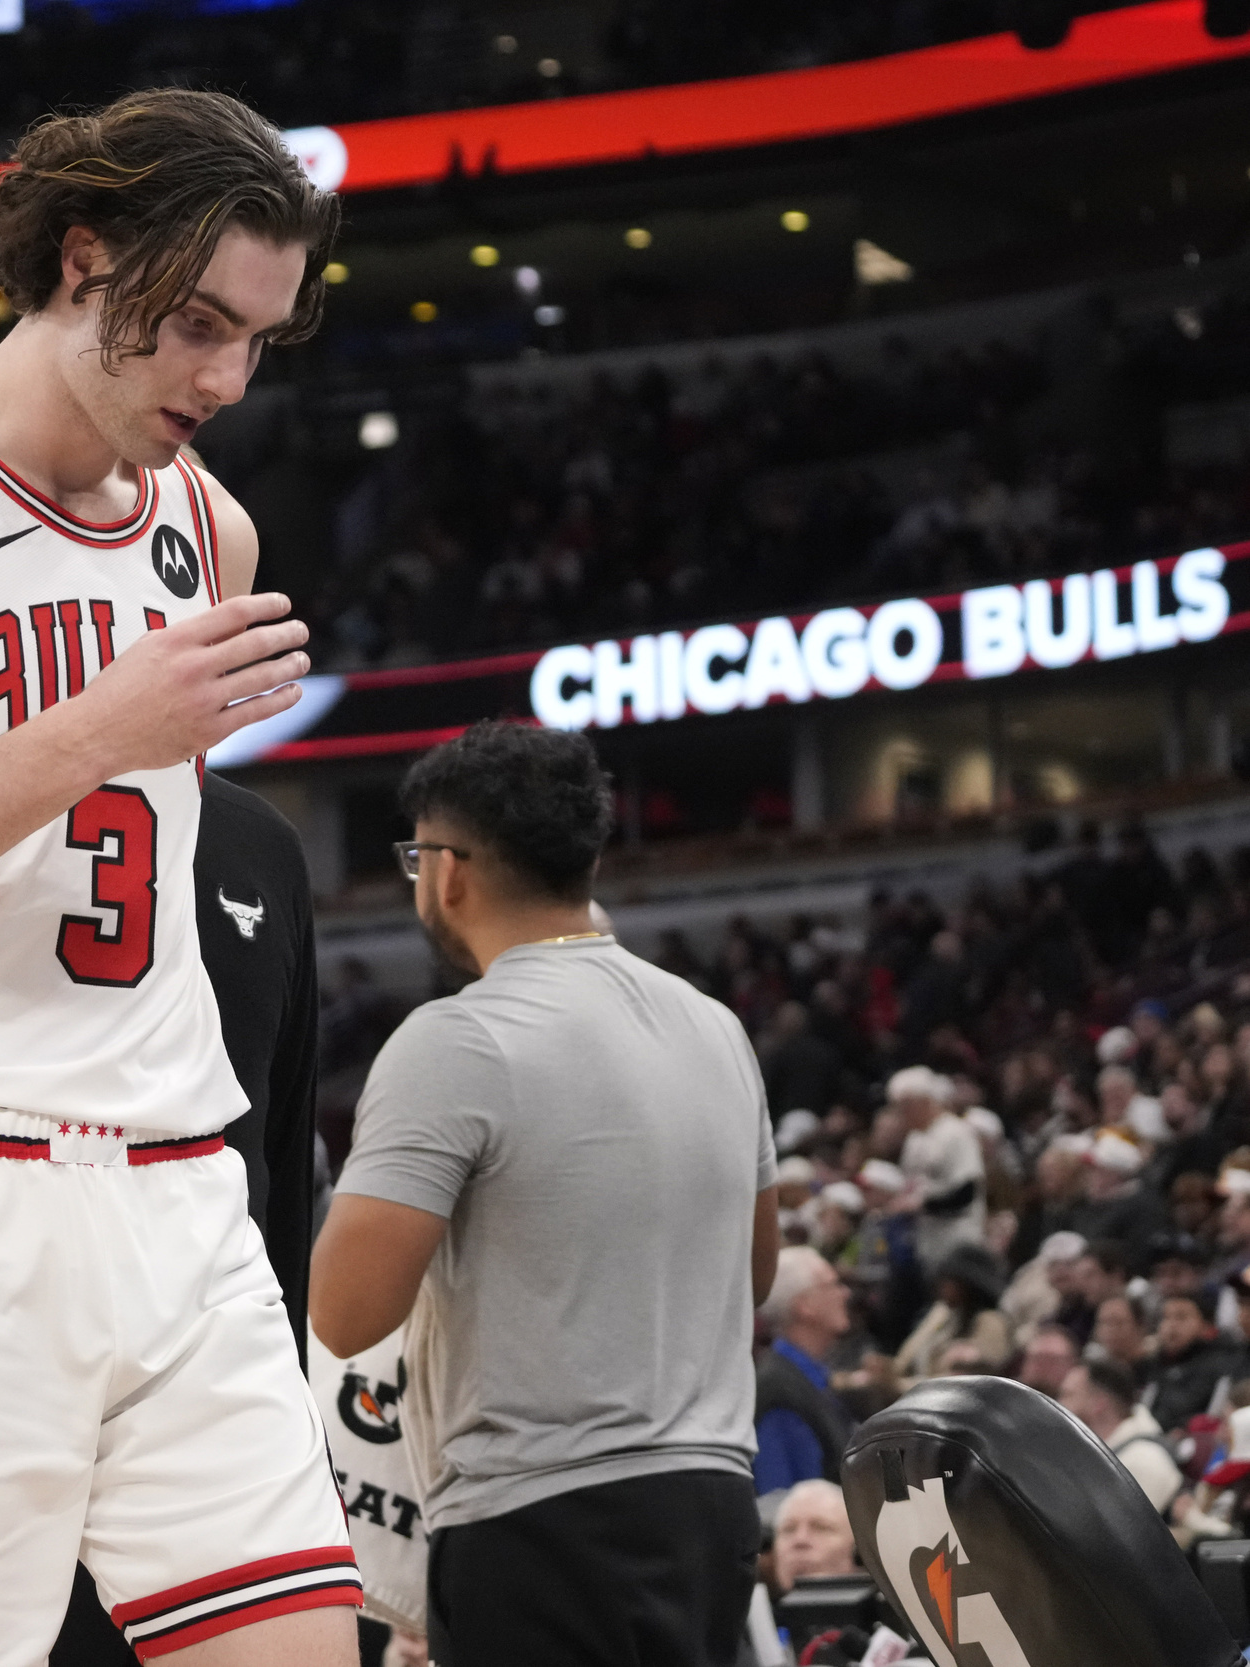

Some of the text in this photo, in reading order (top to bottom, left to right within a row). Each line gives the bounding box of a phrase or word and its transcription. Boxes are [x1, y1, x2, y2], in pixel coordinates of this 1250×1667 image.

[530, 547, 1230, 733] CHICAGO BULLS
[55, 783, 158, 989] 3
